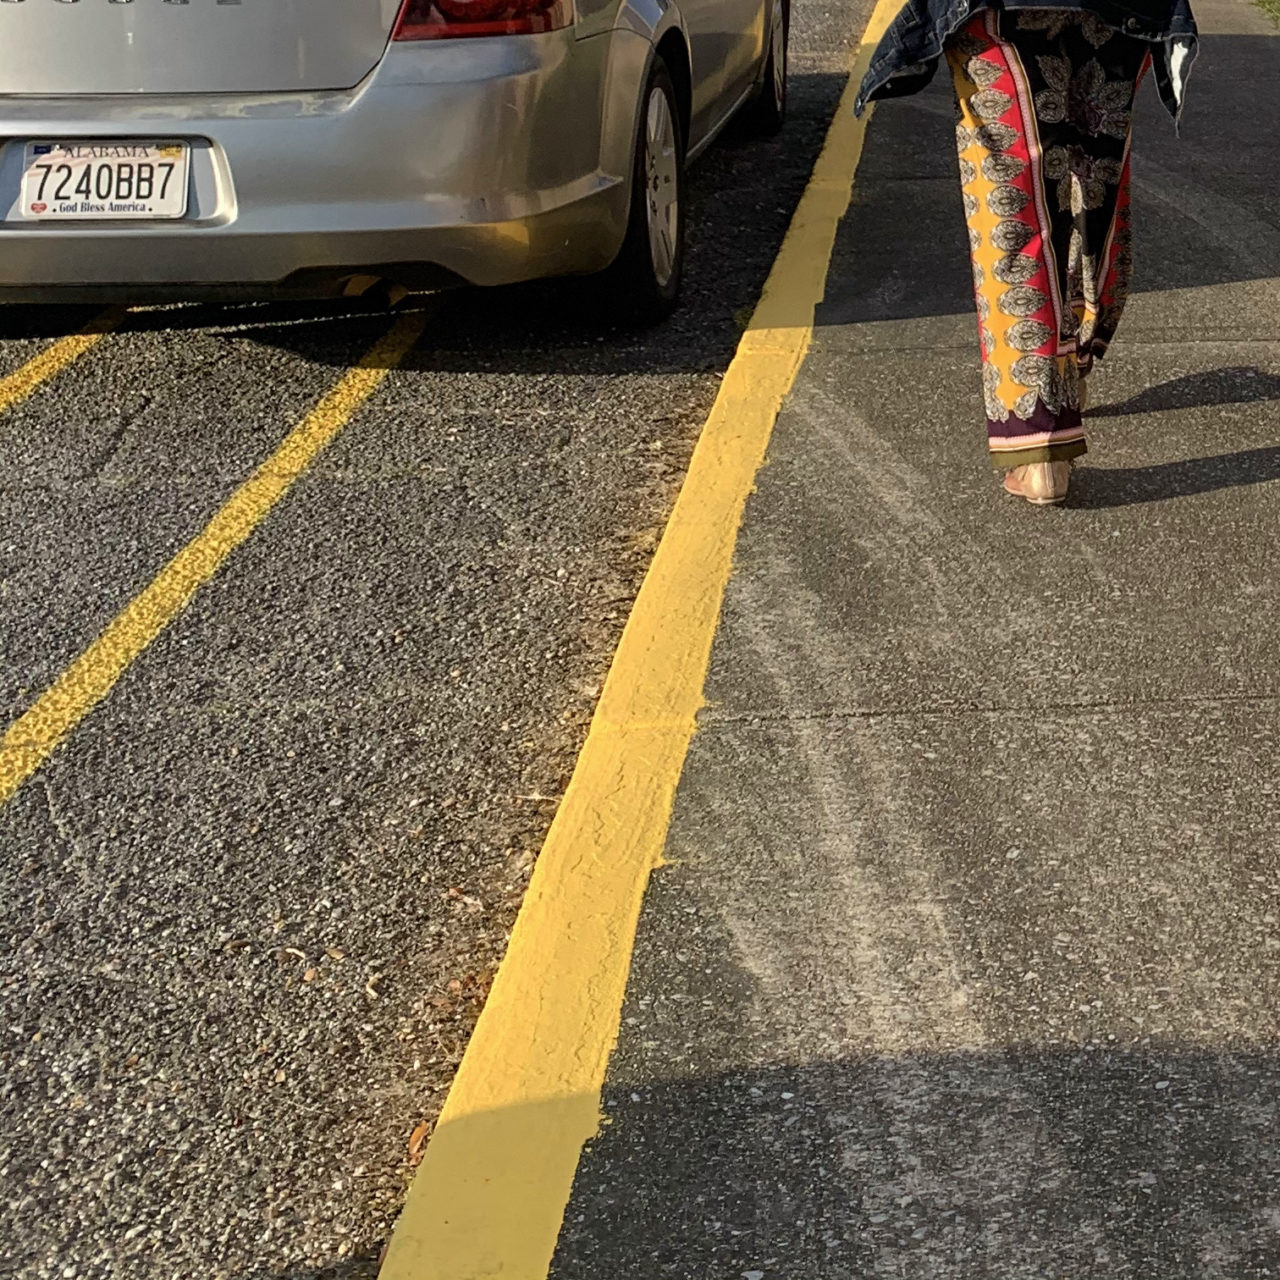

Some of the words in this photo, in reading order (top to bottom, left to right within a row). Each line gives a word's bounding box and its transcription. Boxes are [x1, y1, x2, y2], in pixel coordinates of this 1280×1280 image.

[64, 146, 150, 158] ALABAMA
[35, 162, 176, 202] 7240BB7
[60, 203, 78, 213] God
[80, 203, 105, 213] Bless
[107, 203, 146, 213] America
